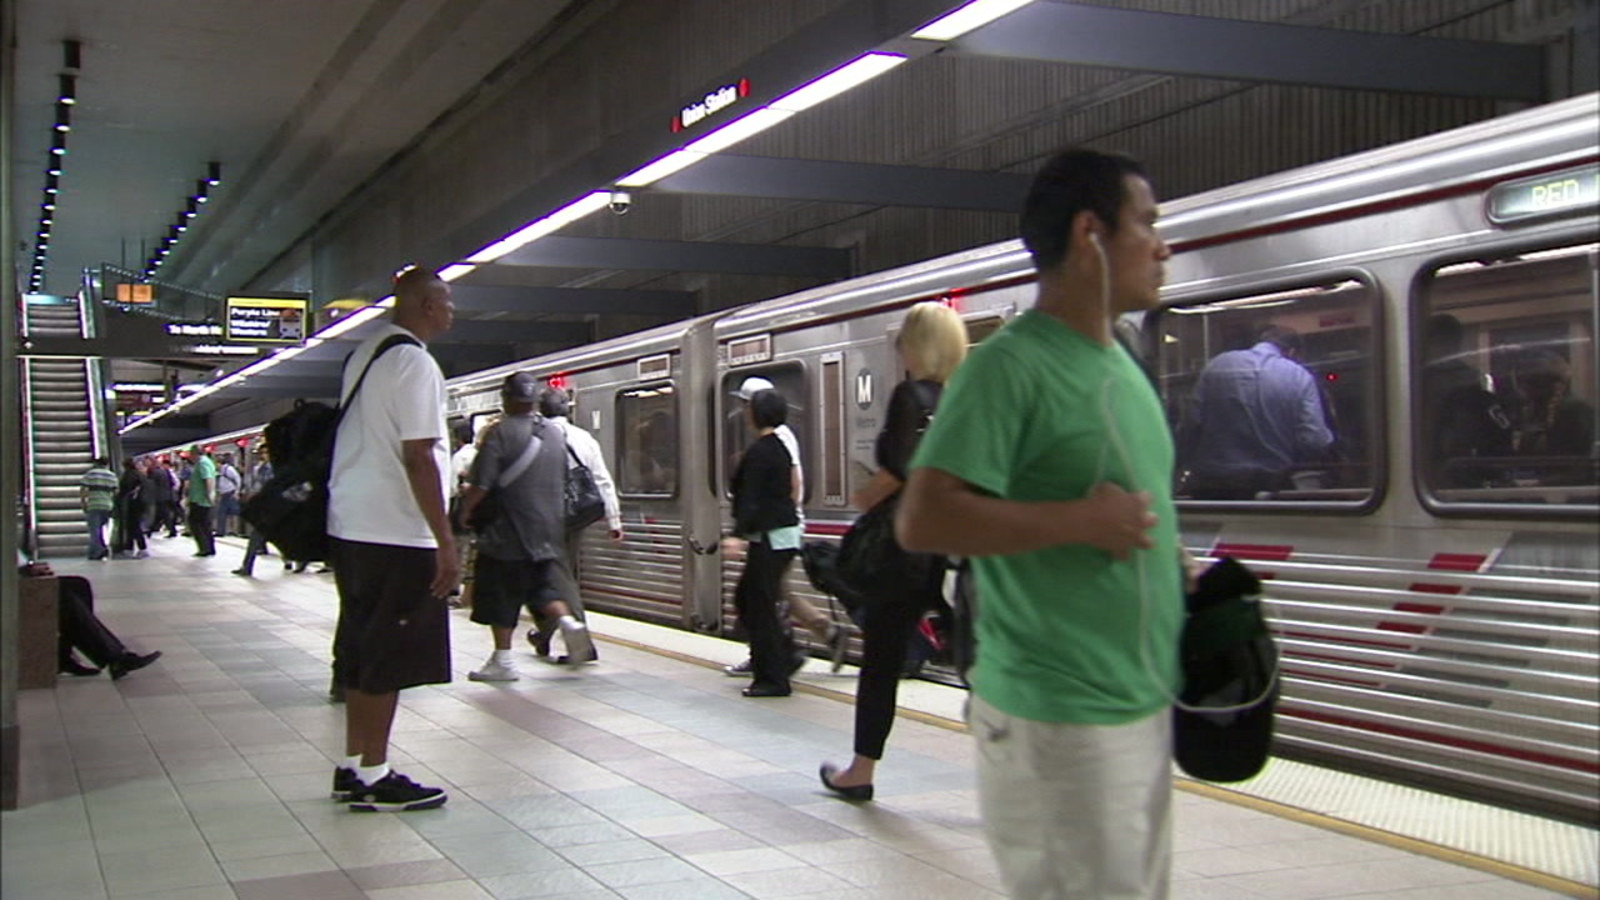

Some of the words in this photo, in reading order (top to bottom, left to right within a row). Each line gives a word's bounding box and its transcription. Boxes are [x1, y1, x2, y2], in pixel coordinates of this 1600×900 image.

[705, 86, 737, 115] Station
[1531, 179, 1580, 206] RED
[231, 308, 260, 318] Purple
[858, 374, 872, 403] M
